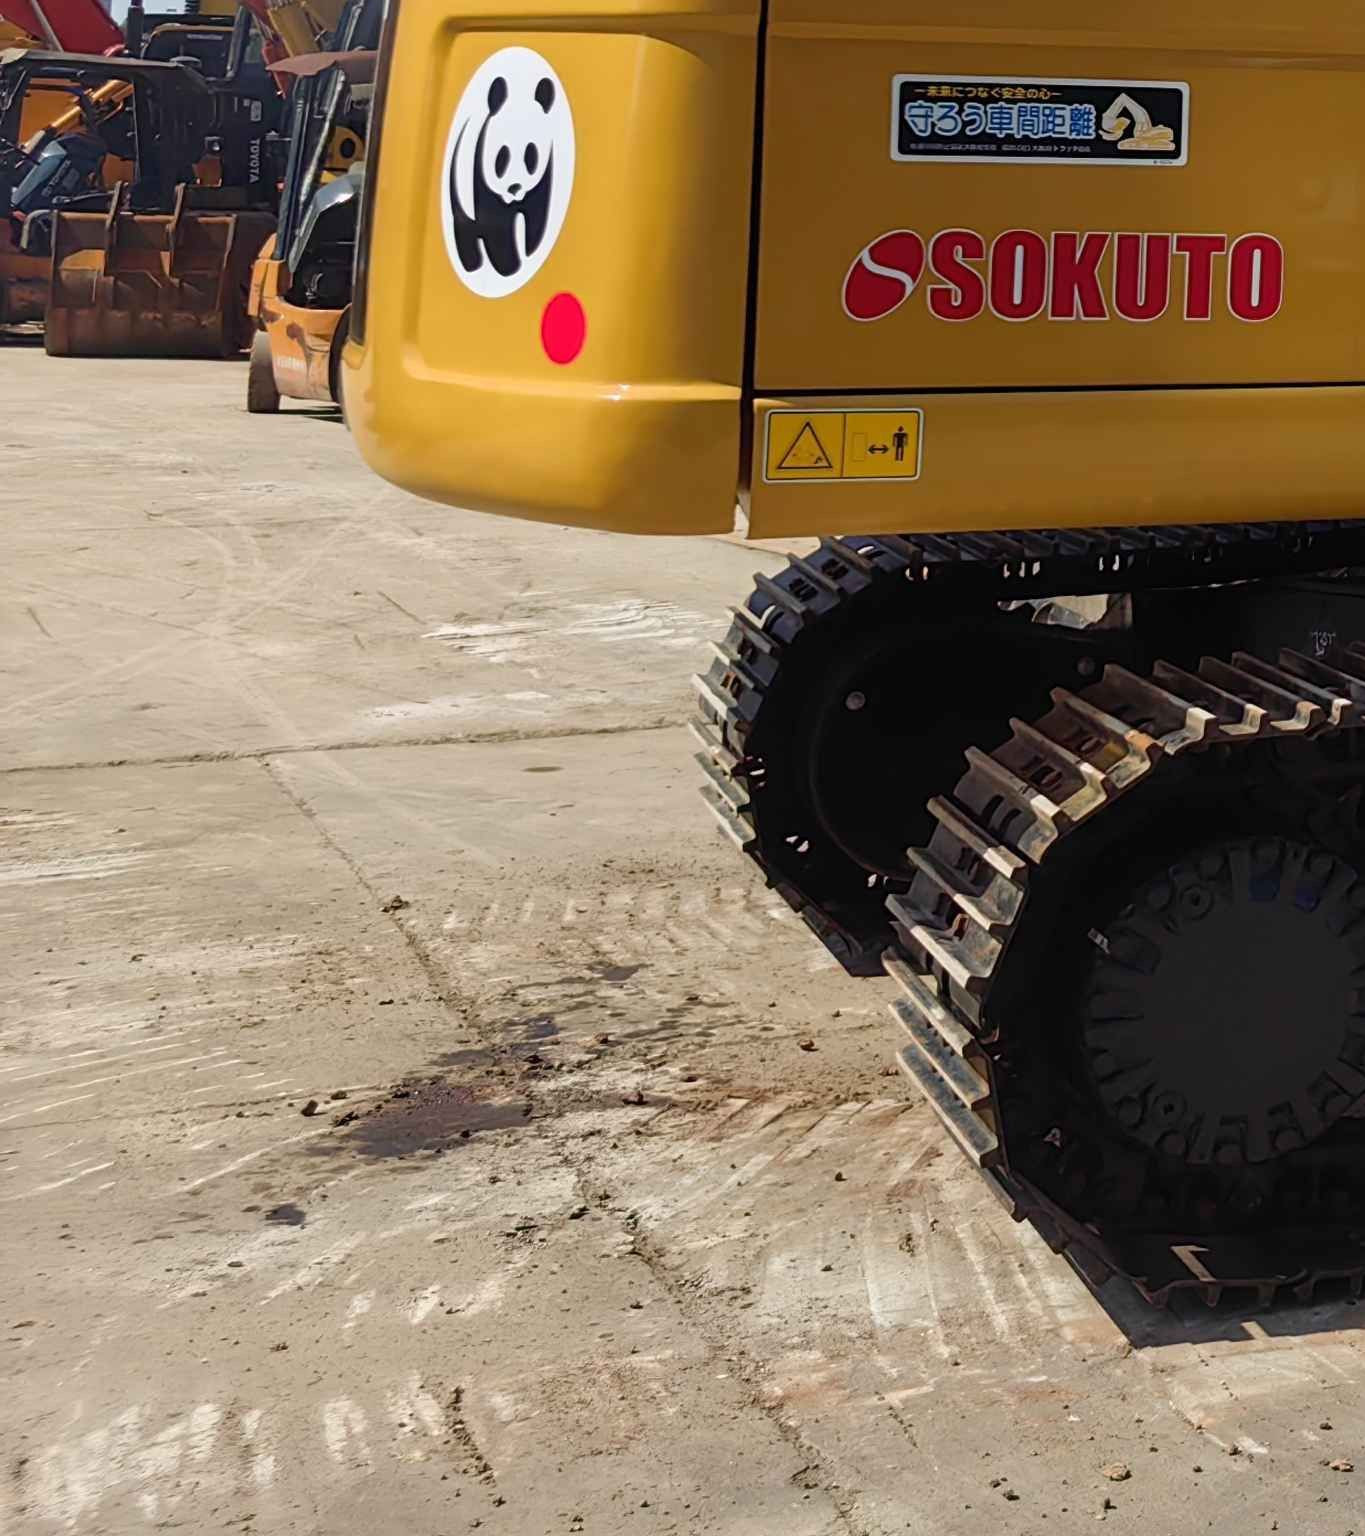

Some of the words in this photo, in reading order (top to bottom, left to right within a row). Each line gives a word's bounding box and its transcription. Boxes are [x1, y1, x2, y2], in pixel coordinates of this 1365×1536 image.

[905, 100, 1096, 140] 守ろう車間距離
[250, 137, 260, 184] TOYOTA
[926, 227, 1285, 323] SOKUTO
